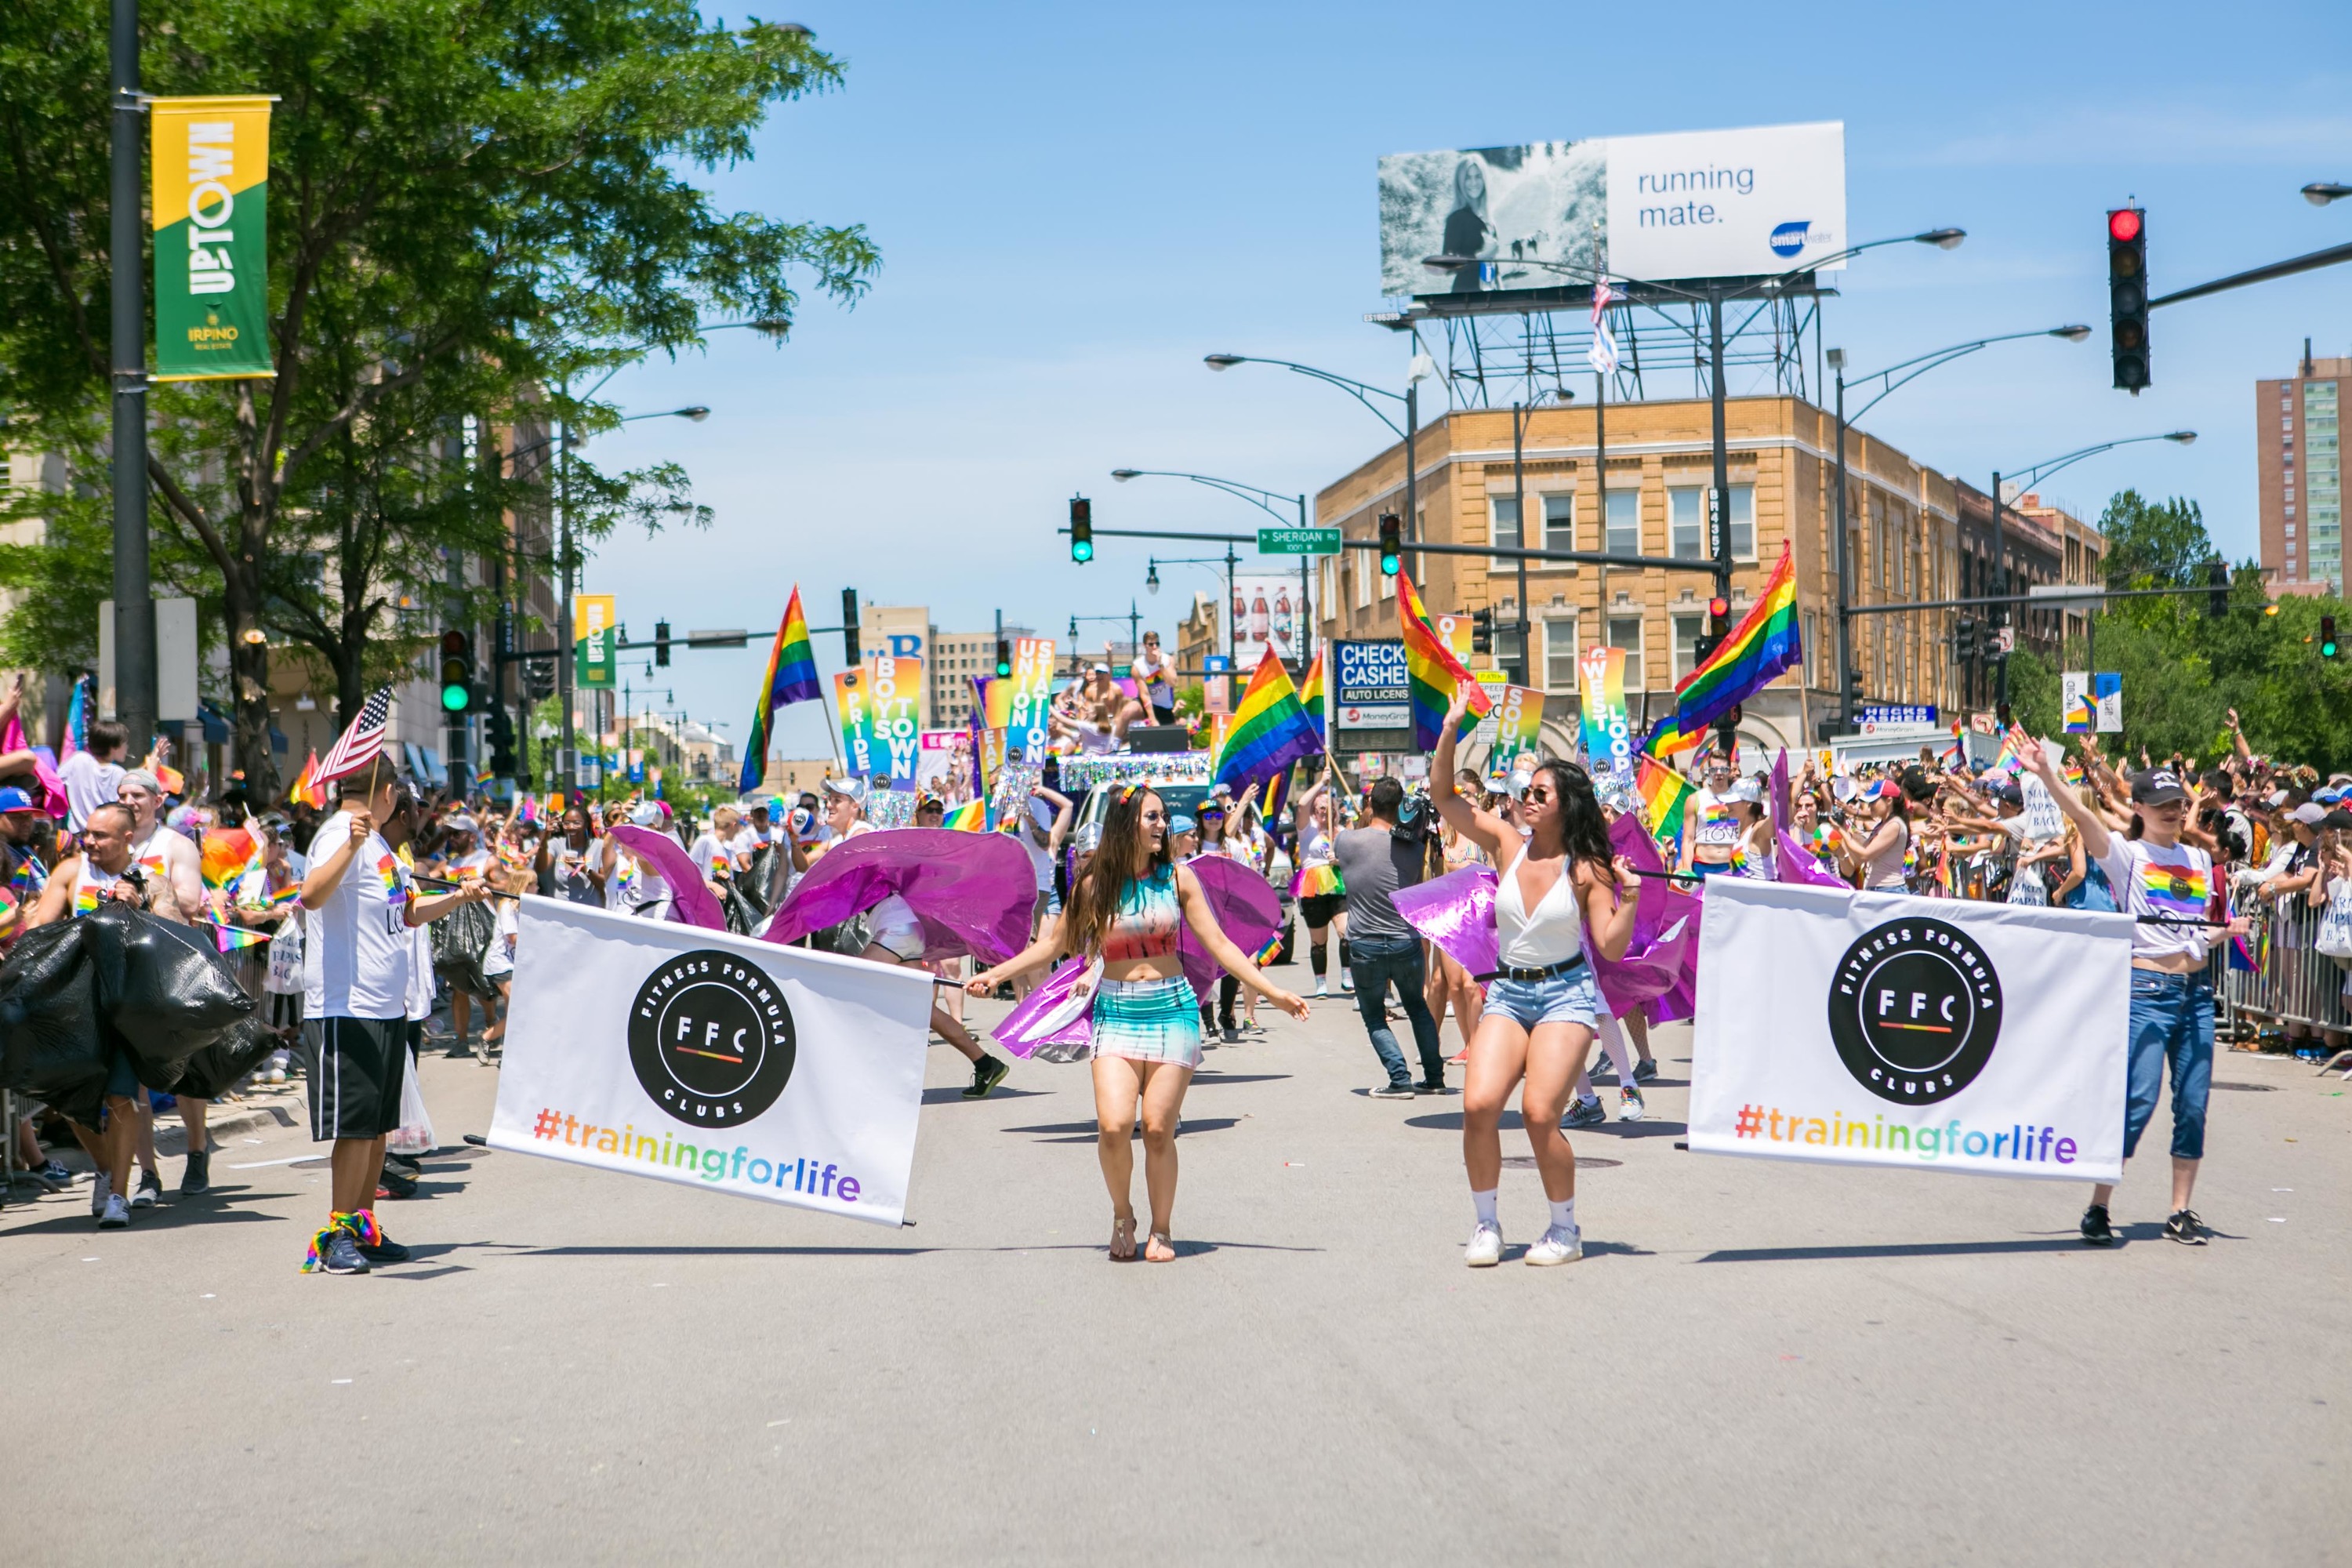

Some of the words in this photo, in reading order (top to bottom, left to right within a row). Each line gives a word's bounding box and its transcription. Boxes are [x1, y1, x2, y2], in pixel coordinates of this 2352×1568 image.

[1639, 163, 1754, 195] running
[188, 122, 235, 296] UPTOWN
[1639, 201, 1723, 228] mate.
[188, 326, 238, 342] IRPINO
[1272, 532, 1323, 543] SHERIDAN
[1341, 644, 1408, 665] CHECK
[1345, 691, 1372, 699] AUTO
[1581, 661, 1608, 731] WEST
[1608, 704, 1630, 773] LOOP
[1865, 707, 1927, 716] HECKS
[847, 692, 870, 771] PRIDE
[1841, 928, 1912, 996] FITNESS
[1925, 929, 1994, 1010] FORMULA
[641, 960, 710, 1019] FITNESS
[722, 964, 786, 1046] FORMULA
[1878, 989, 1955, 1022] FFC
[677, 1016, 747, 1053] FFC
[1871, 1068, 1953, 1094] CLUBS
[664, 1088, 743, 1117] CLUBS
[1735, 1103, 2078, 1164] #trainingforlife
[533, 1107, 862, 1202] #trainingforlife
